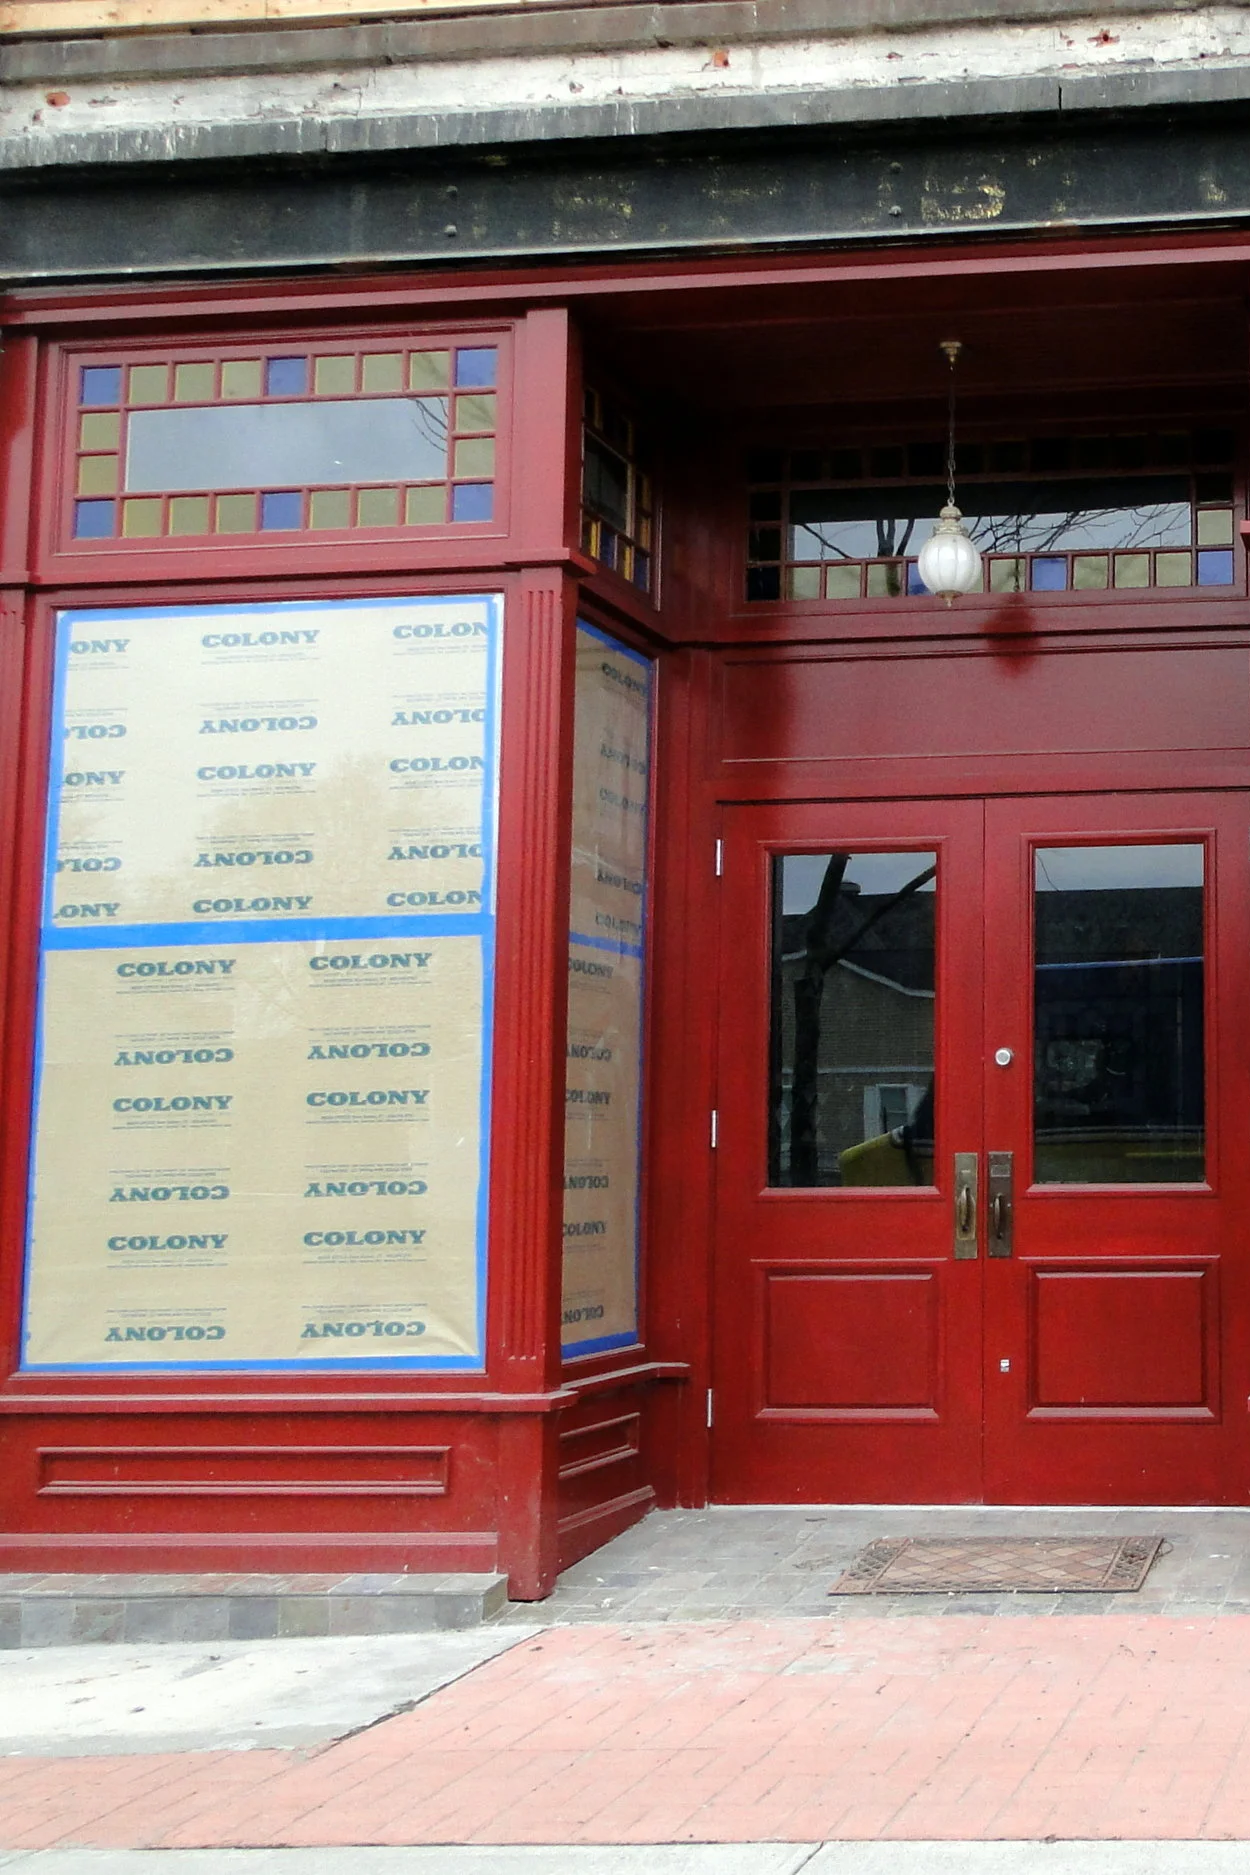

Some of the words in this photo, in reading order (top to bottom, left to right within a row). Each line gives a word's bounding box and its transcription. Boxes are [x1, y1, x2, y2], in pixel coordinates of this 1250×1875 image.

[201, 629, 320, 647] COLONY
[197, 716, 318, 735] COLONY
[196, 761, 318, 781] COLONY
[191, 849, 314, 869] COLONY
[53, 902, 121, 919] ONY
[192, 894, 315, 914] COLONY
[116, 958, 235, 977] COLONY
[308, 951, 435, 970] COLONY
[111, 1047, 234, 1067] COLONY
[306, 1042, 431, 1061] COLONY
[112, 1094, 233, 1113] COLONY
[305, 1088, 428, 1106] COLONY
[106, 1185, 230, 1203] COLONY
[301, 1180, 428, 1199] COLONY
[107, 1233, 227, 1251] COLONY
[303, 1228, 427, 1247] COLONY
[103, 1325, 226, 1343] COLONY
[298, 1321, 426, 1340] COLONY
